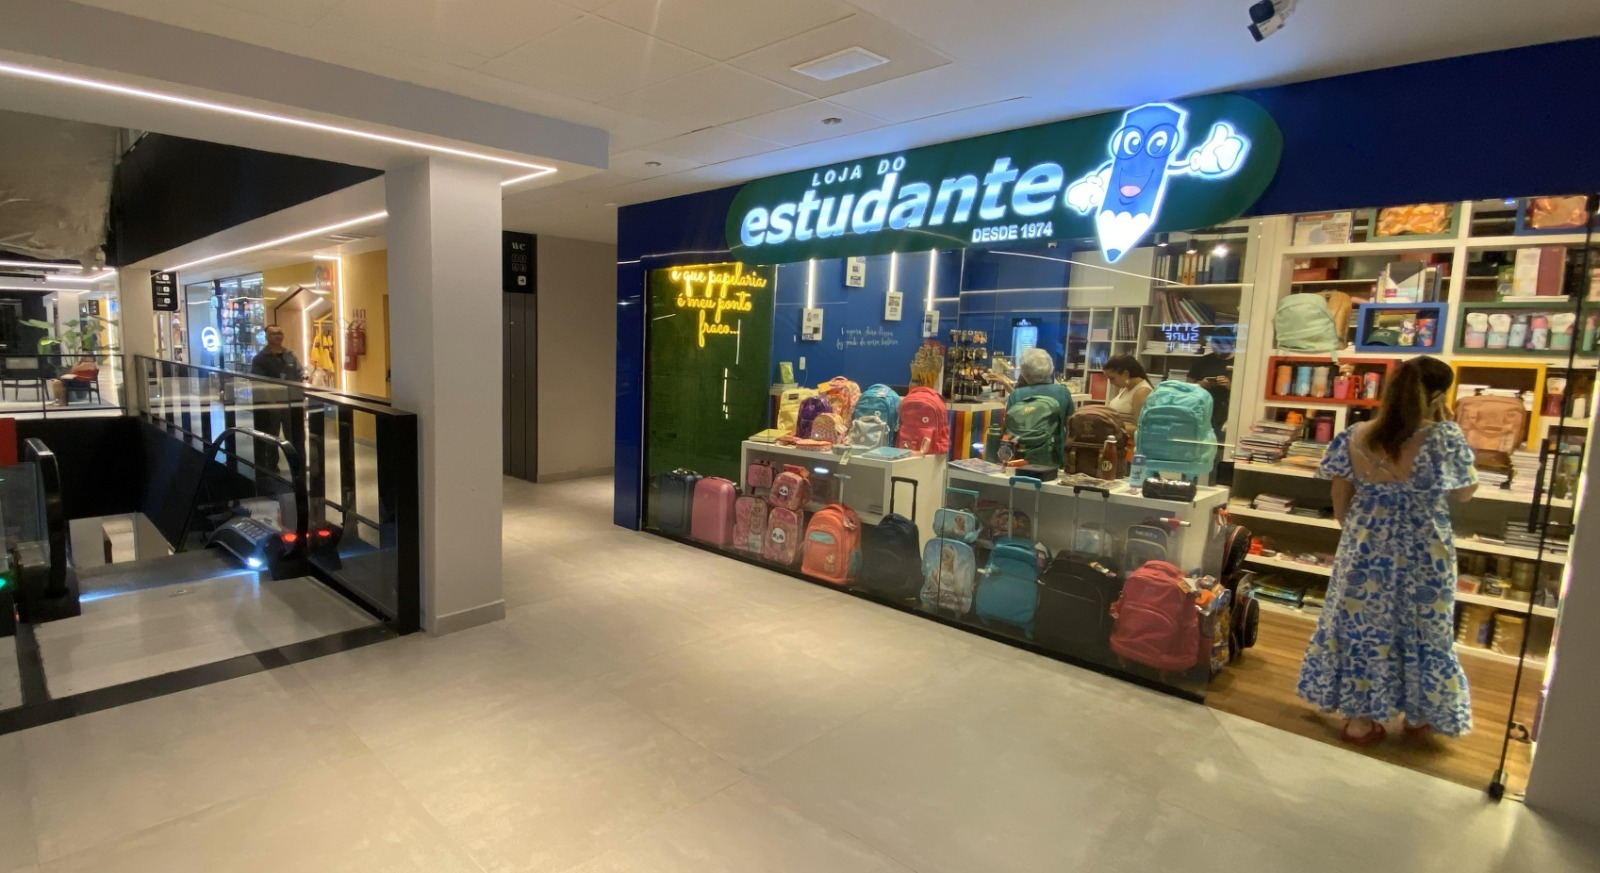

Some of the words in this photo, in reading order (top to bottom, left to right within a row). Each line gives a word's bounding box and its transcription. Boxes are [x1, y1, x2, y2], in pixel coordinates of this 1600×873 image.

[811, 164, 862, 187] LOJA
[877, 156, 906, 175] DO
[740, 157, 1064, 246] estudante
[511, 241, 526, 251] WC
[971, 224, 1018, 243] DESDE
[1020, 221, 1053, 239] 1974
[683, 270, 706, 297] que
[705, 261, 767, 299] papelaria
[677, 292, 686, 307] é
[686, 298, 716, 309] meu
[715, 291, 752, 324] ponto
